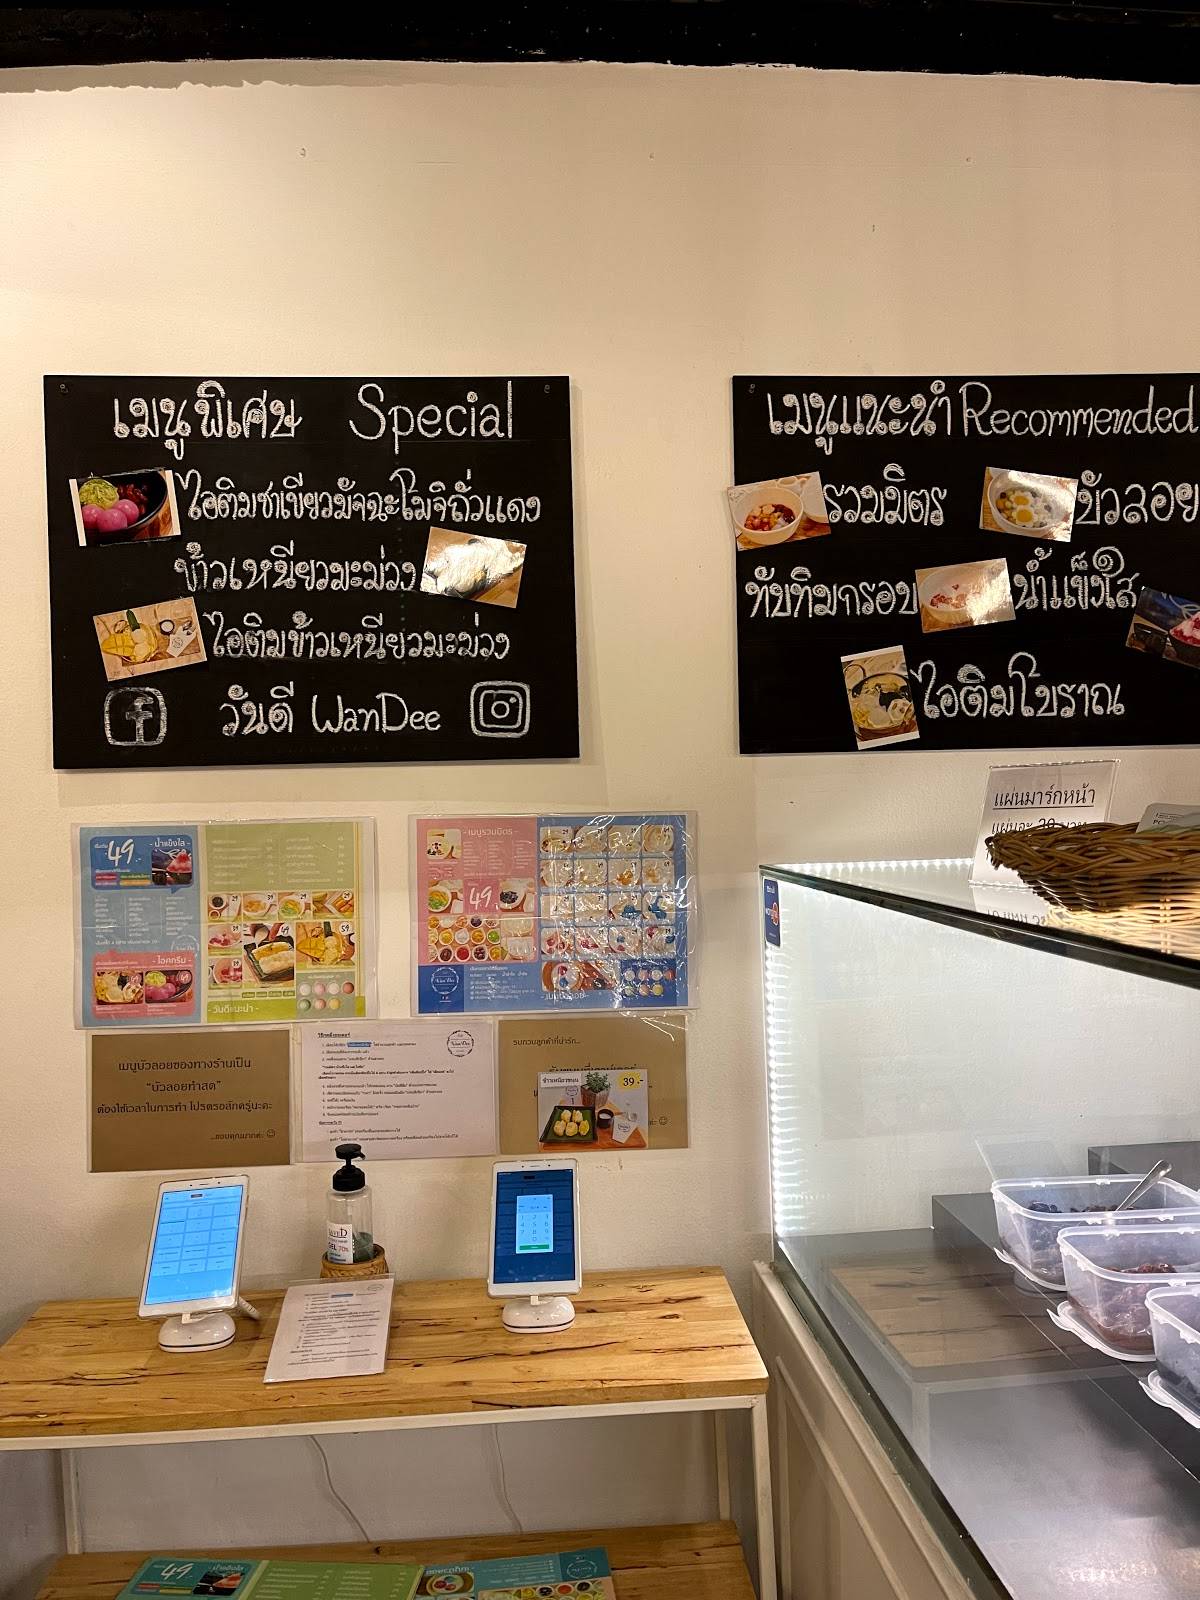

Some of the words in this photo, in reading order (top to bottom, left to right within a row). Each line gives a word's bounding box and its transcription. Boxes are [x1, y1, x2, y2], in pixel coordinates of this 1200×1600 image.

[114, 380, 303, 460] เมนูพิเศษ
[350, 380, 514, 454] Special
[767, 380, 951, 455] เมนูแนะนำ
[959, 382, 1200, 438] Recommended
[822, 463, 948, 526] รวมมิตร
[1075, 469, 1200, 526] บัวลอย
[173, 539, 417, 592] ข้าวเหนียวมะม่วง
[744, 565, 919, 619] ทับทิมกรอบ
[202, 610, 511, 660] ไอติมข้าวเหนียวมะม่วง
[220, 681, 294, 735] วันดี
[312, 693, 442, 733] WanDee
[909, 651, 1126, 719] ไอติมโบราณ
[994, 782, 1097, 807] แผ่นมาร์กหน้า
